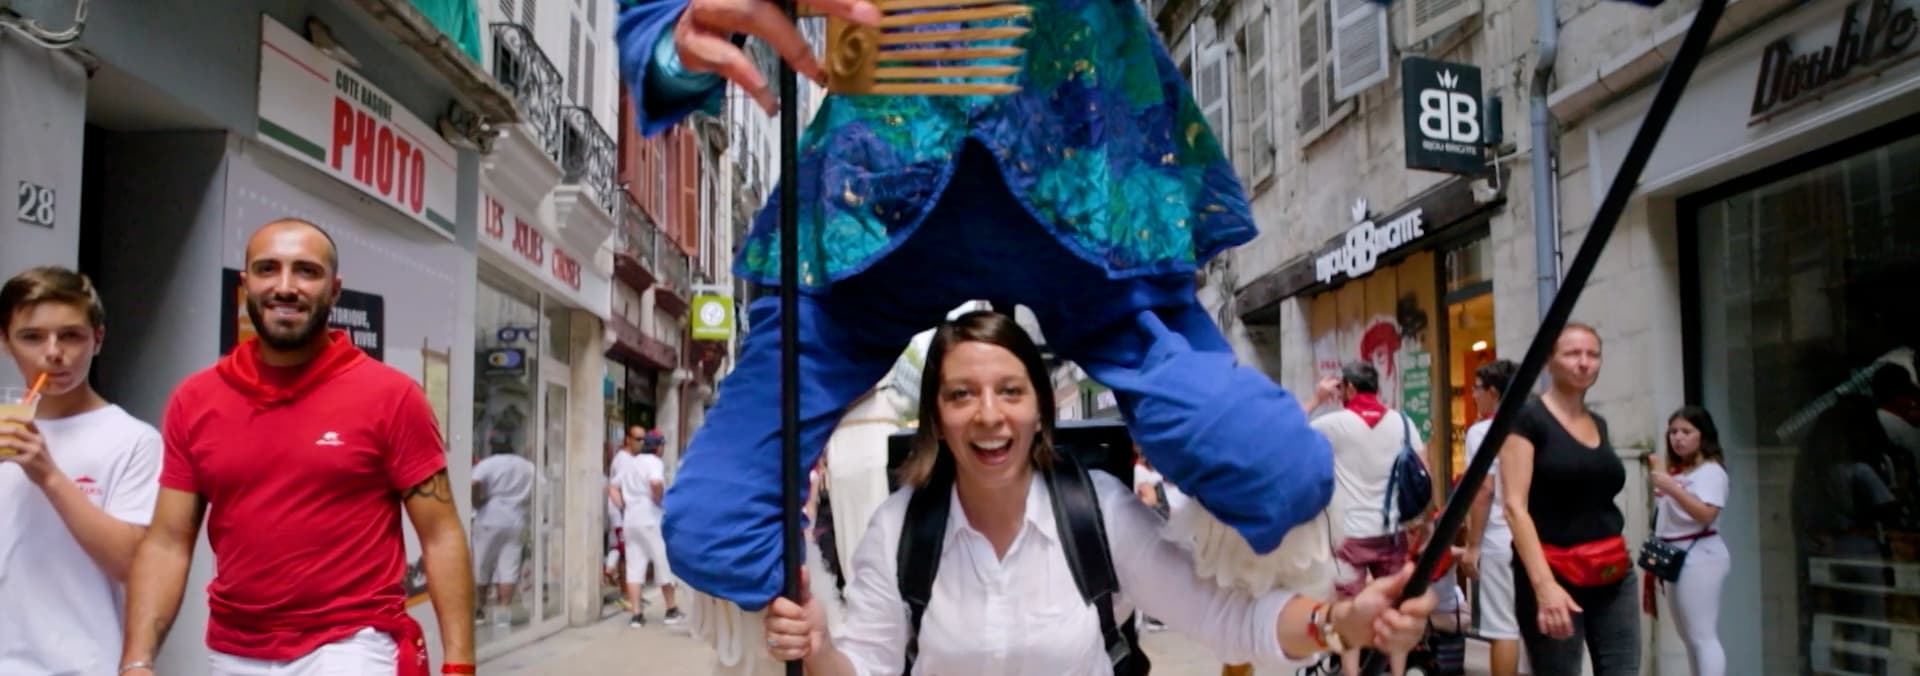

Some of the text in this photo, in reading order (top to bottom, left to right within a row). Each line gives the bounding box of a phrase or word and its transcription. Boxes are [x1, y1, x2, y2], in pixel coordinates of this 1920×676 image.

[1750, 0, 1919, 117] Double
[331, 95, 426, 215] PHOTO
[19, 182, 54, 225] 28
[485, 194, 504, 239] LES
